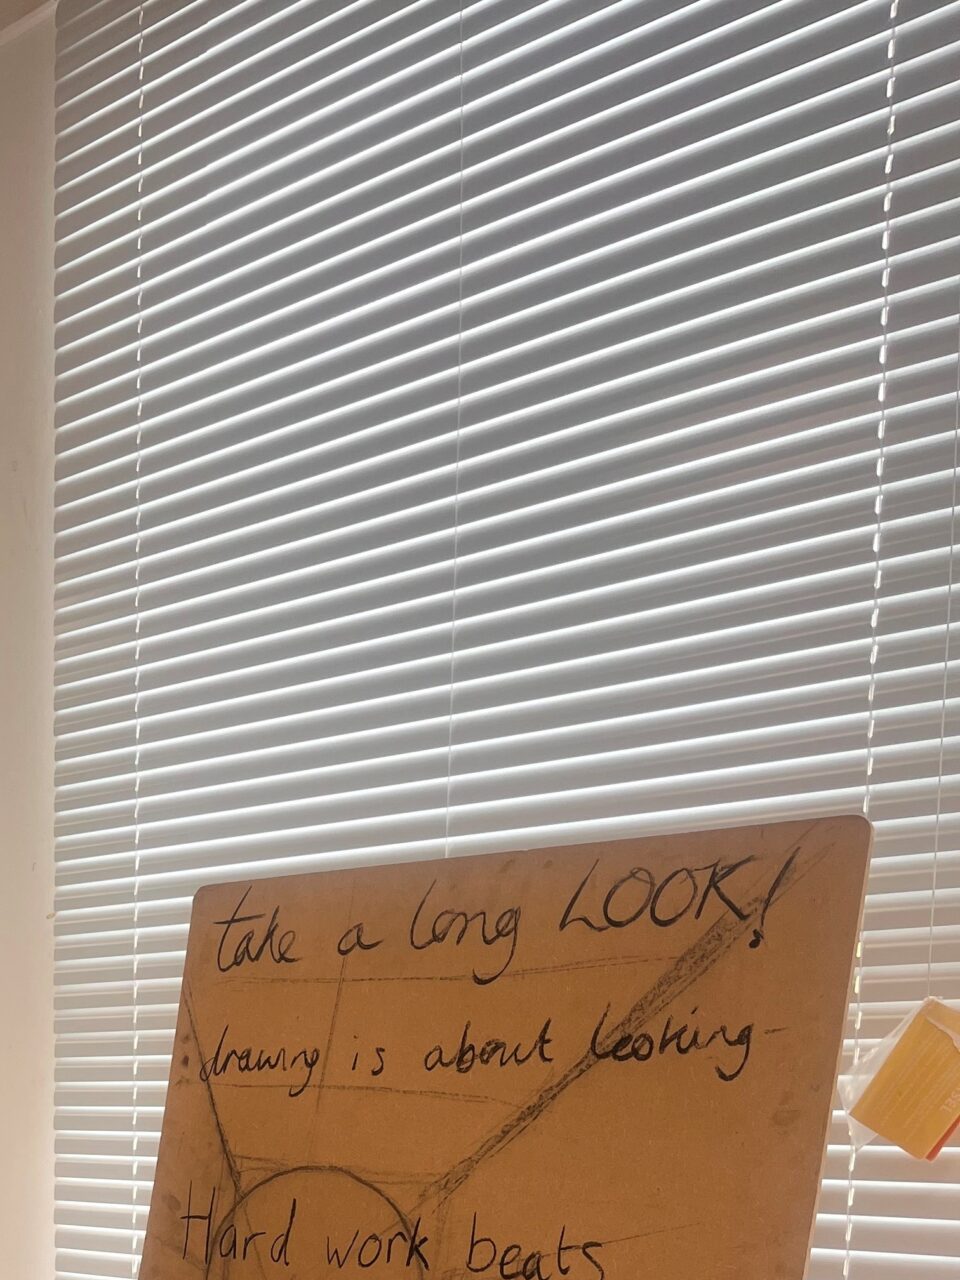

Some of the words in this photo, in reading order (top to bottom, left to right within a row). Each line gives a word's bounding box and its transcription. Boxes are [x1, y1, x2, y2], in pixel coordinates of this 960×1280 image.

[214, 884, 302, 972] take
[339, 920, 381, 952] a
[409, 879, 522, 985] long
[559, 846, 800, 950] LOOK!
[200, 1023, 320, 1097] drawing
[351, 1034, 387, 1076] is
[424, 1016, 554, 1074] about
[180, 1180, 298, 1267] Hard
[326, 1219, 431, 1271] work
